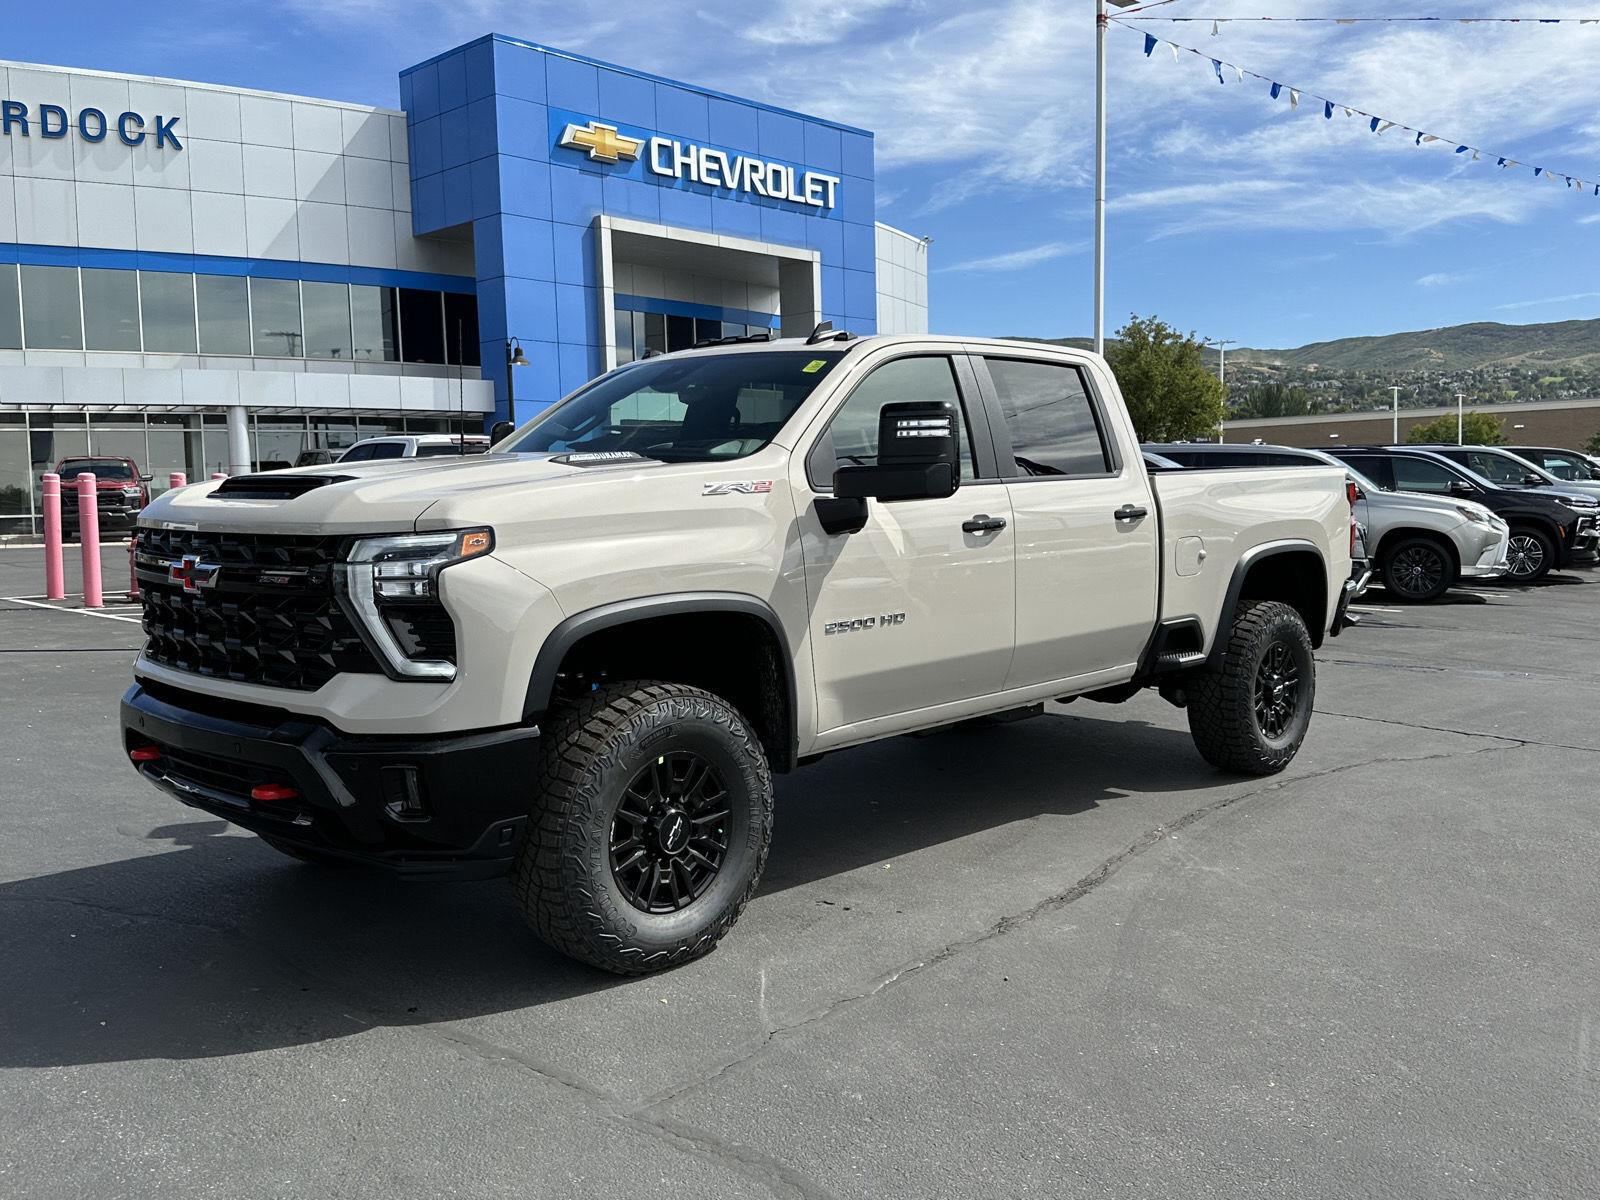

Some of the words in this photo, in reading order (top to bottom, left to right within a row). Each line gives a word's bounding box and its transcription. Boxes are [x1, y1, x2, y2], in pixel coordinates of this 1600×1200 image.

[2, 100, 183, 150] RDOCK
[651, 136, 840, 209] CHEVROLET
[593, 451, 632, 460] DURAMAX
[702, 480, 773, 497] ZR2
[825, 617, 876, 636] 2500
[880, 612, 905, 628] HD
